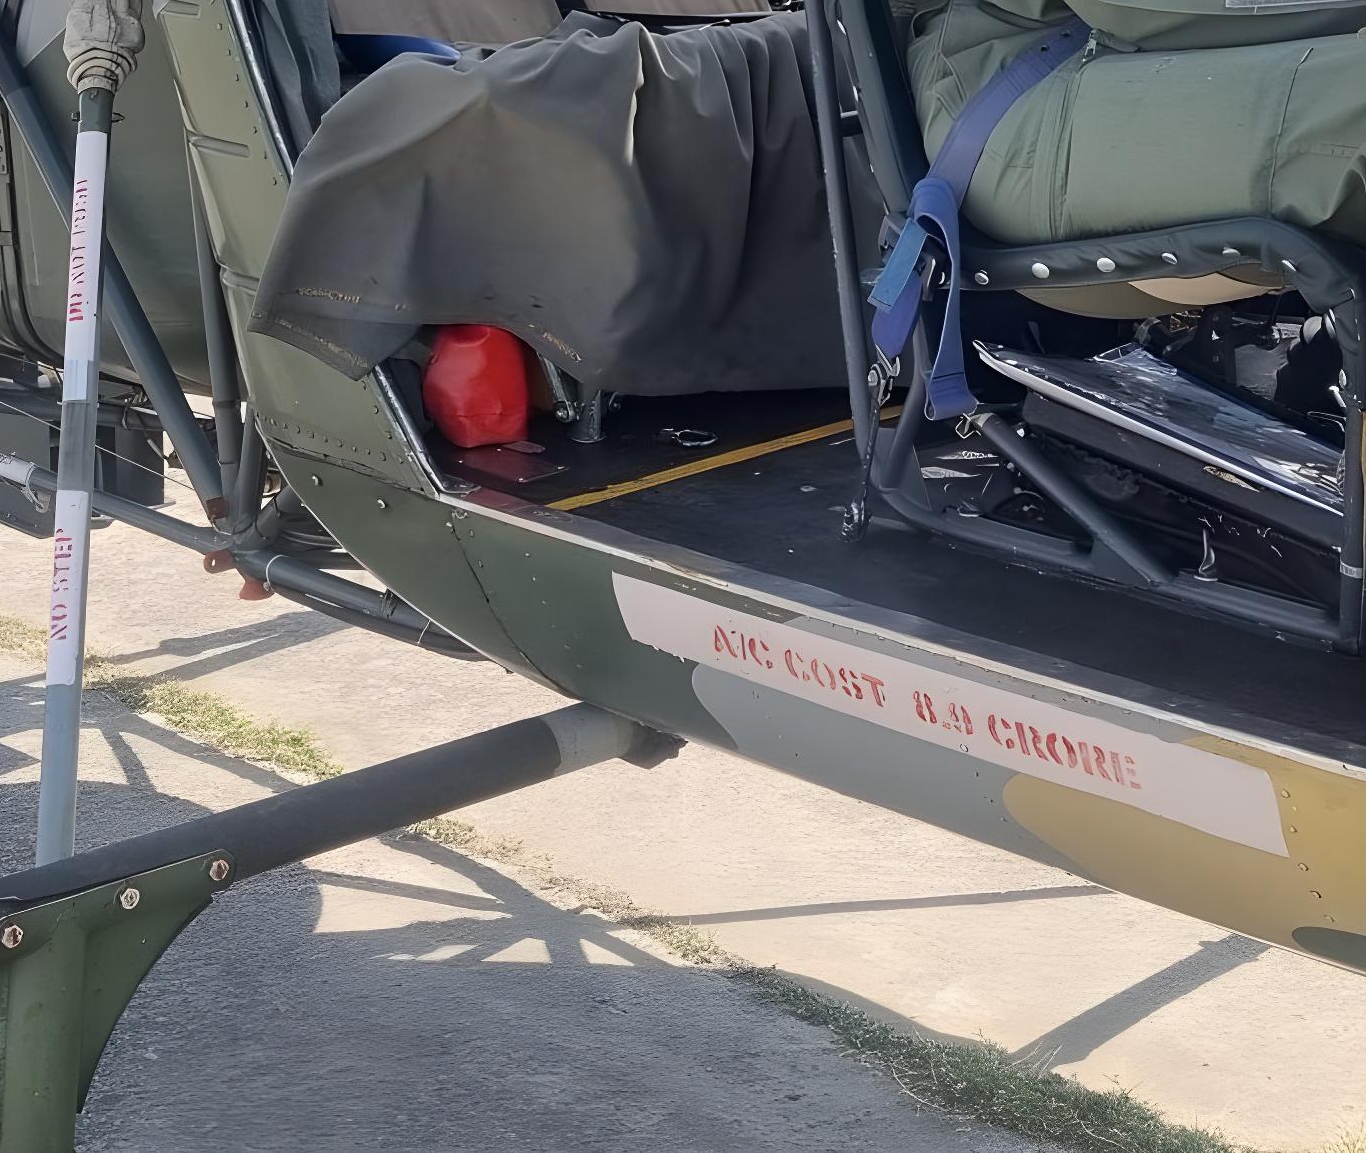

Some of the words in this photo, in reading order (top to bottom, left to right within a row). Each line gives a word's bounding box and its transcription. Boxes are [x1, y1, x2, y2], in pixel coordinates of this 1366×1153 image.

[50, 603, 68, 641] NO
[713, 624, 774, 670] A/C
[785, 648, 886, 708] COST
[987, 713, 1143, 790] CRORE
